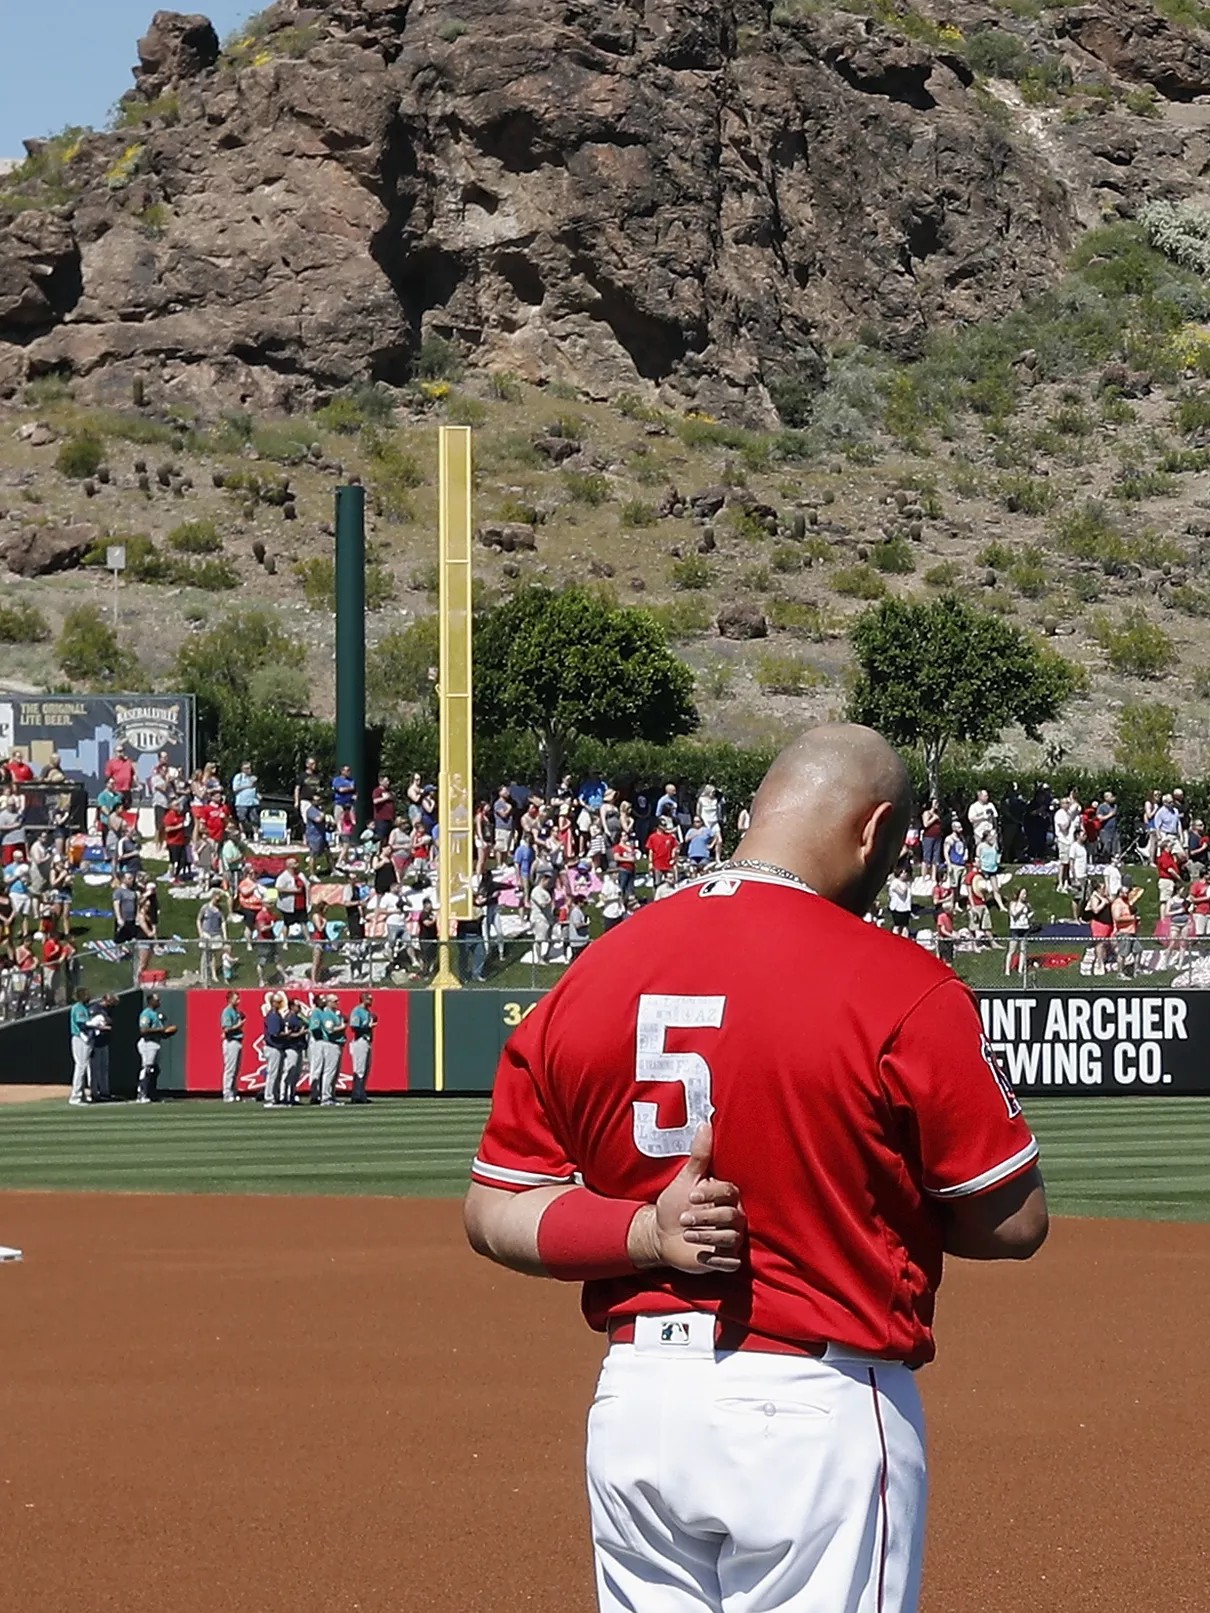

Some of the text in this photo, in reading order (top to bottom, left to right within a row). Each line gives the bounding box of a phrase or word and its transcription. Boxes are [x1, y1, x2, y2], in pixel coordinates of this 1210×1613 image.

[20, 703, 88, 715] THE ORIGINAL
[20, 714, 42, 726] LITE
[1044, 997, 1188, 1040] ARCHER
[631, 993, 727, 1158] 5
[1113, 1041, 1172, 1085] CO.
